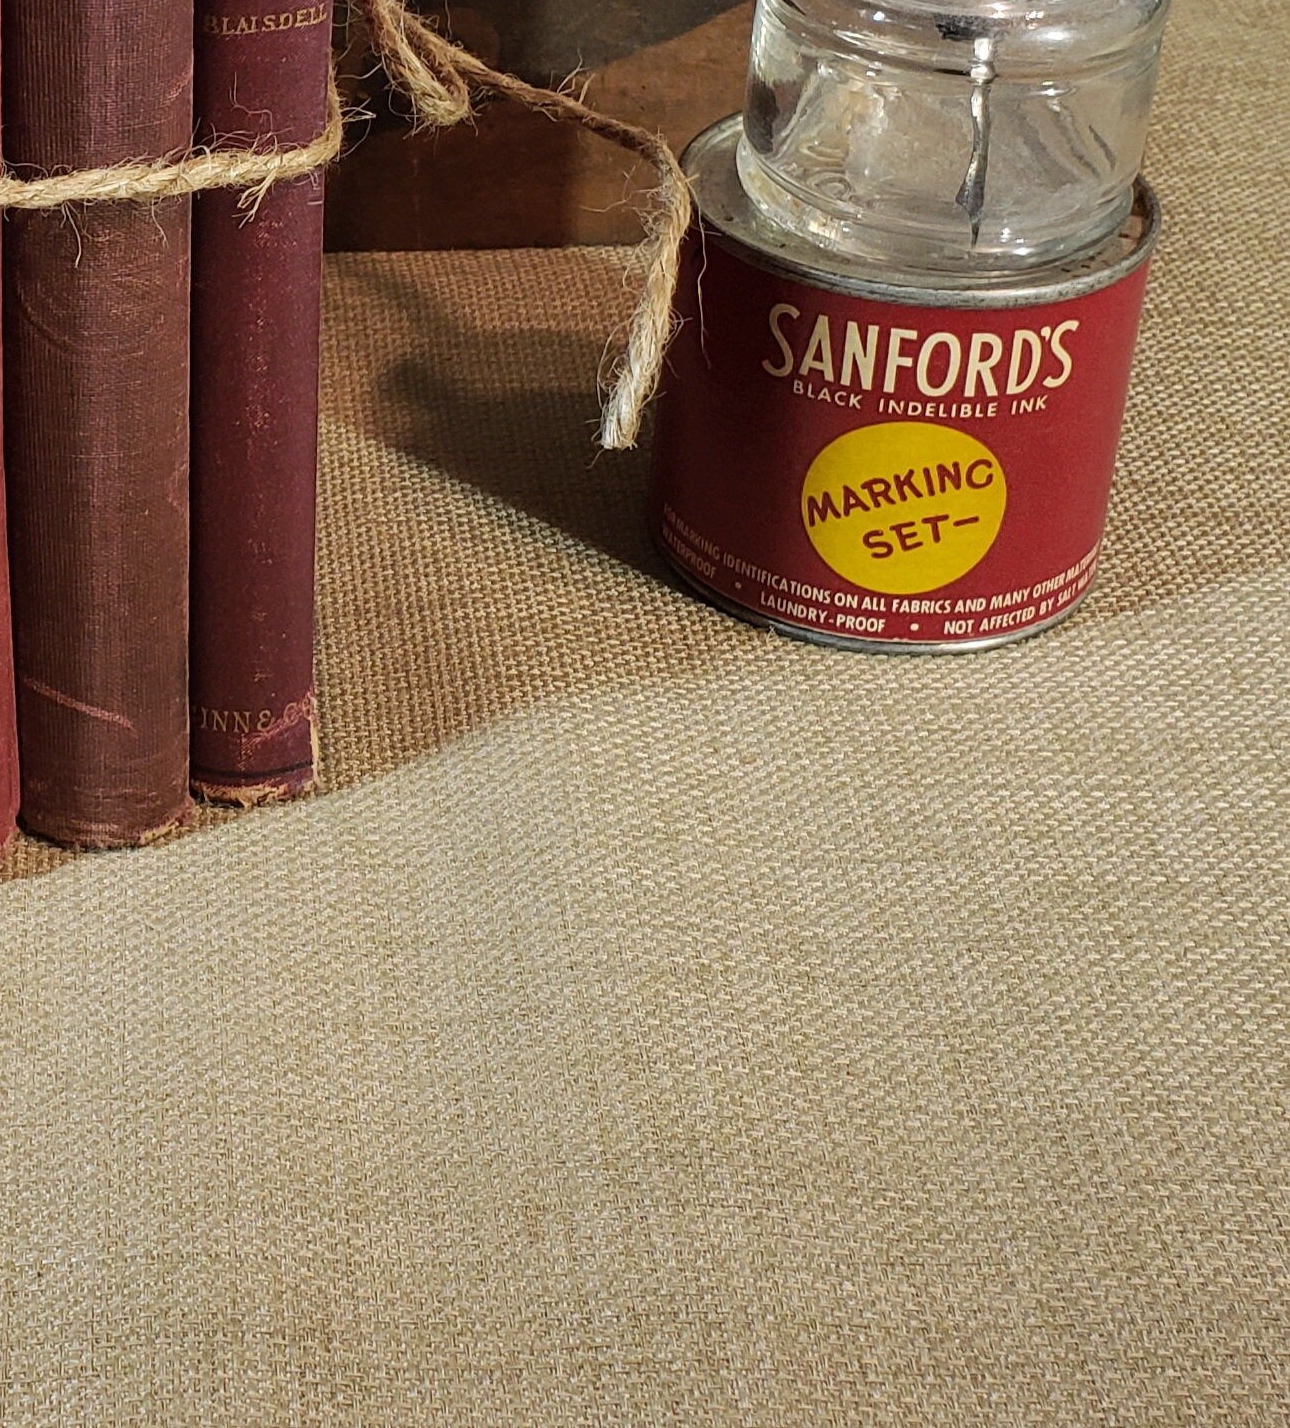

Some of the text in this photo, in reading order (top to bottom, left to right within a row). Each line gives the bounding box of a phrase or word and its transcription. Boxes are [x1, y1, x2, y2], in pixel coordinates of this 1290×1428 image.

[203, 2, 328, 37] BLAISDELL
[761, 302, 1081, 398] SANFORD'S
[792, 379, 1048, 419] BLACK INDELIBLE INK
[807, 458, 995, 528] MARKING
[722, 551, 832, 605] IDENTIFICATIONS
[834, 592, 859, 610] ON
[861, 595, 887, 613] ALL
[891, 598, 952, 614] FABRICS
[954, 597, 987, 614] AND
[990, 586, 1031, 611] MANY
[1032, 572, 1066, 599] OTHER
[760, 591, 886, 634] LAUNDRY-PROOF
[943, 619, 975, 636] NOT
[979, 605, 1036, 632] AFFECTED
[1038, 596, 1055, 616] BY
[193, 707, 252, 734] INN
